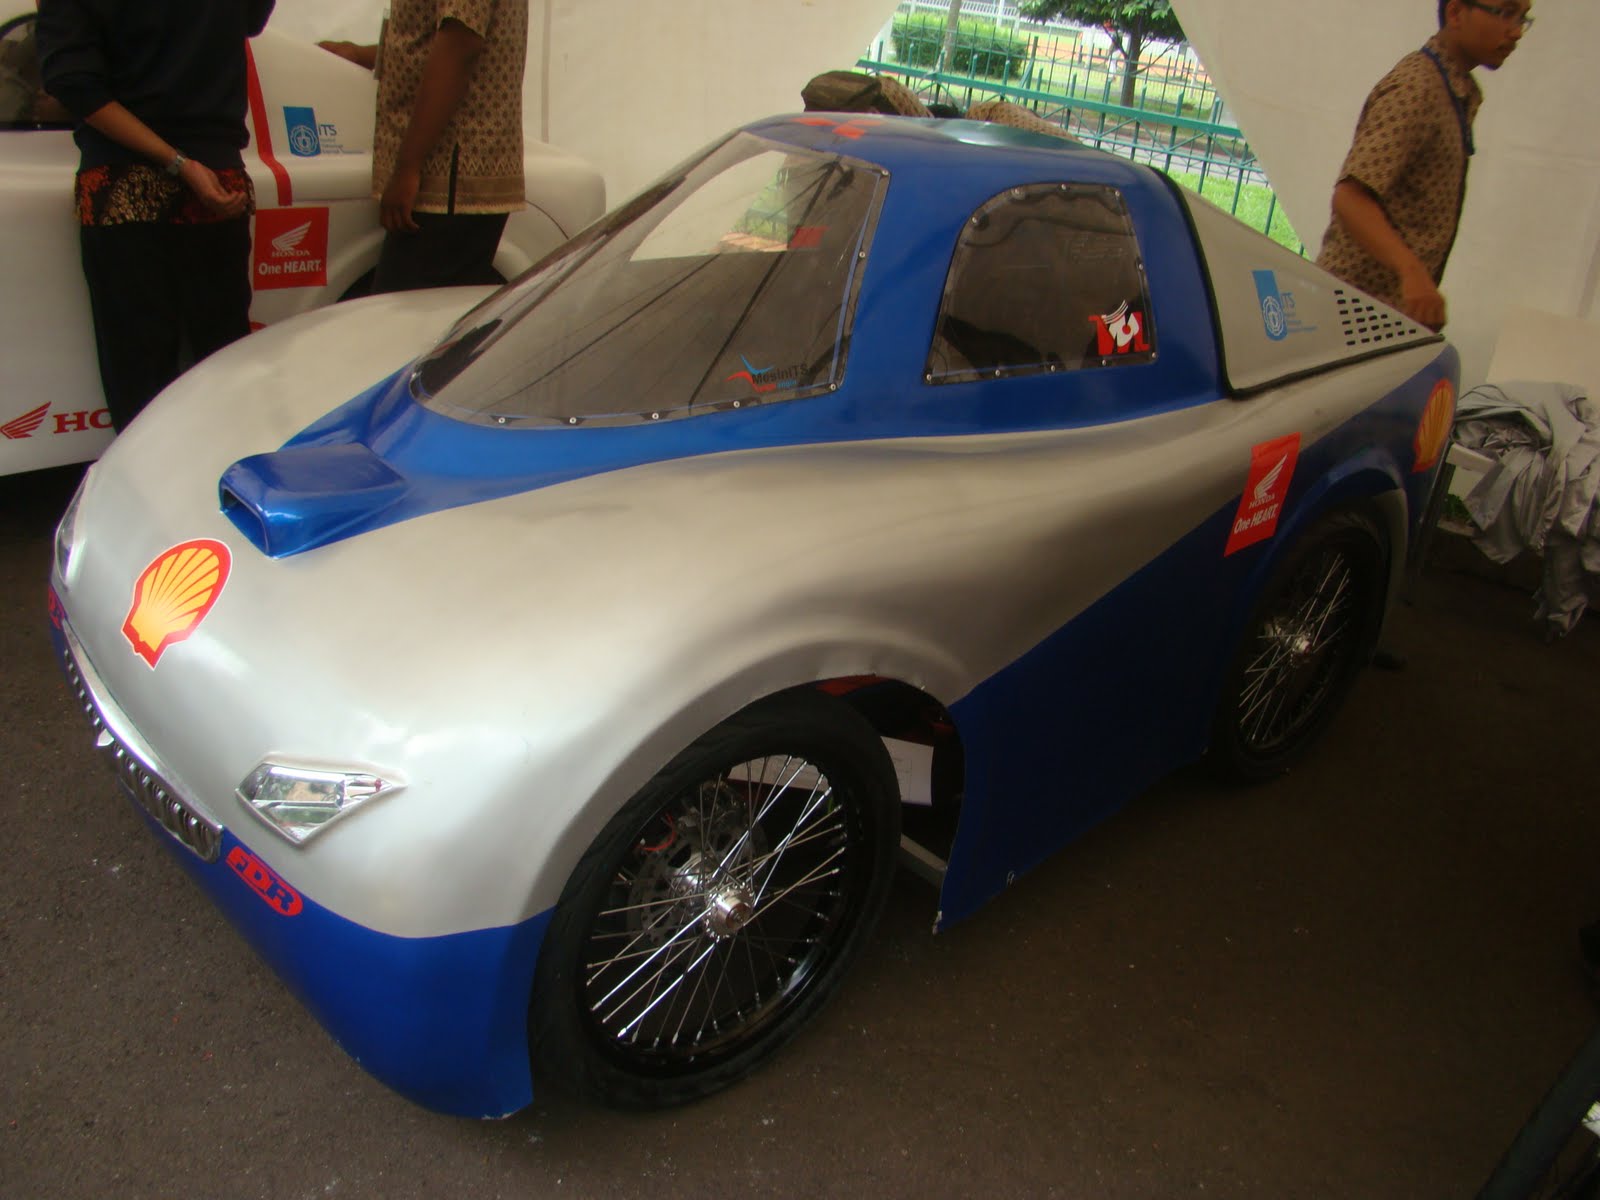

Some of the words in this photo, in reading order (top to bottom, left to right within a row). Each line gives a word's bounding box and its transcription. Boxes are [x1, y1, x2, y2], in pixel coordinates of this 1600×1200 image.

[258, 262, 282, 275] One
[1234, 518, 1251, 534] One
[227, 846, 298, 914] FDR
